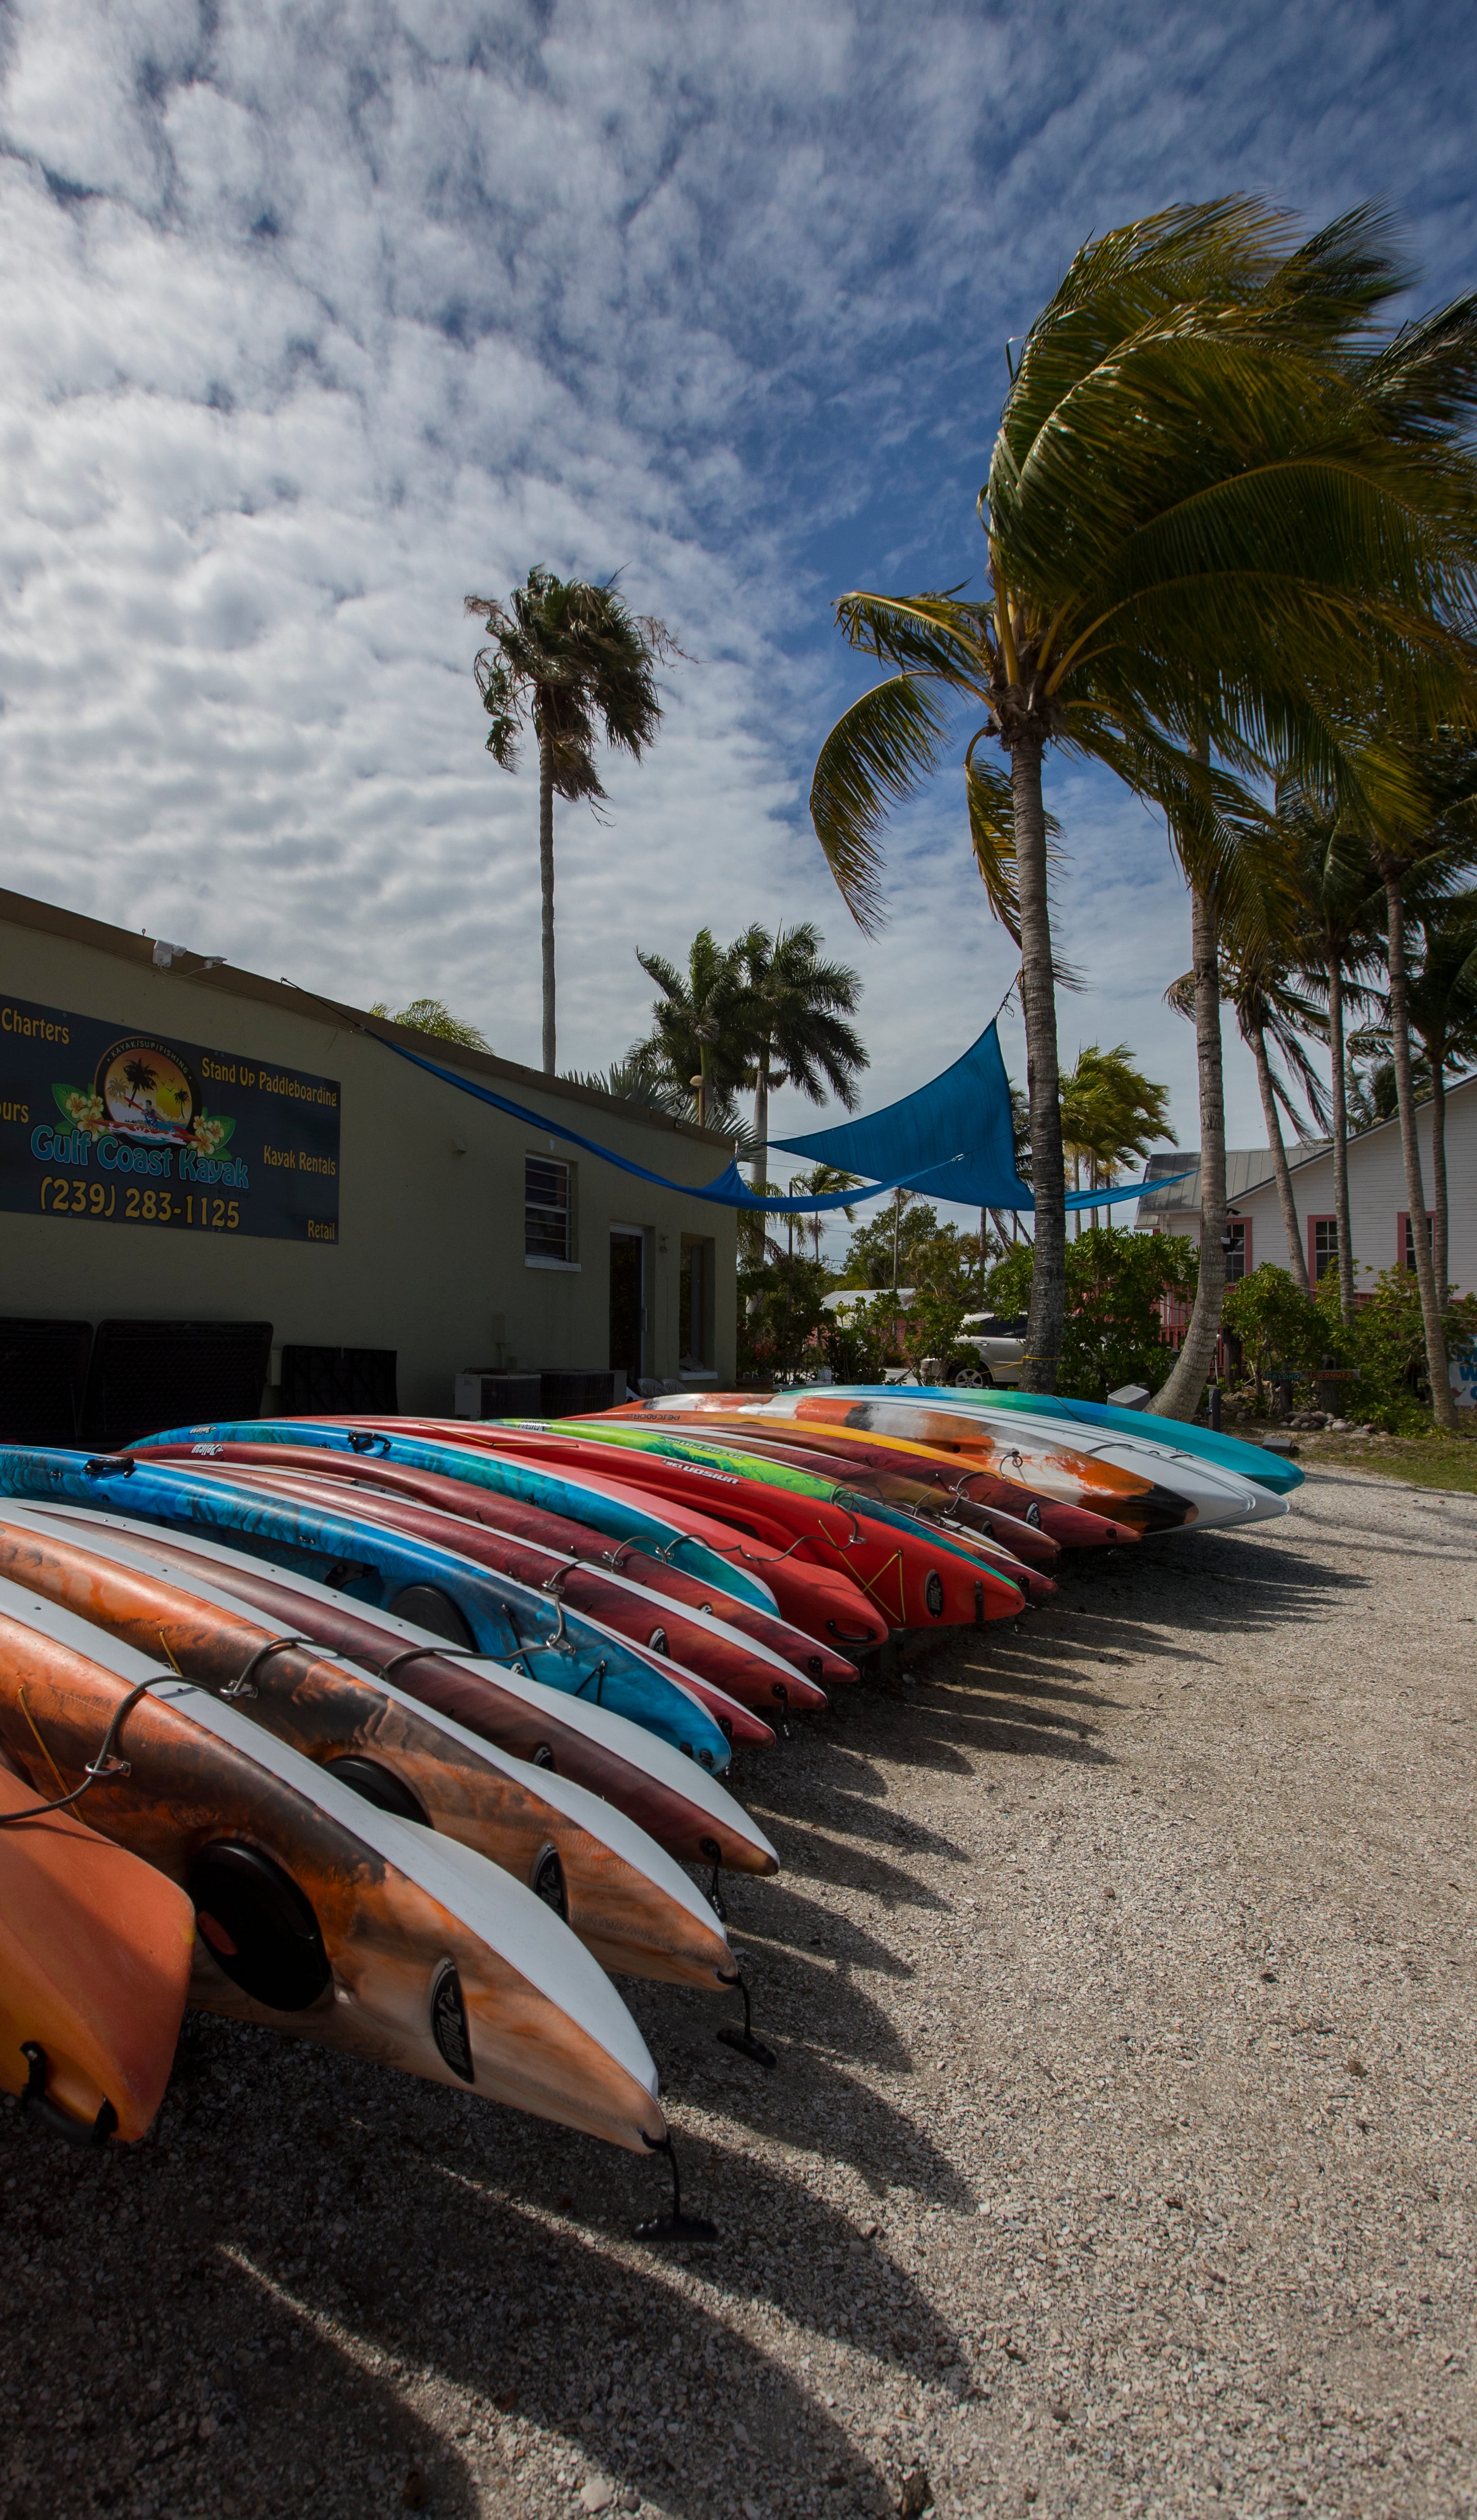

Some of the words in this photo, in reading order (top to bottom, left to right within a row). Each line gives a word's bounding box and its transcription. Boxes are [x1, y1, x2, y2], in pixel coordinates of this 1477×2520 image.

[2, 1007, 70, 1045] Charters
[202, 1057, 236, 1083] Stand
[240, 1066, 256, 1087] Up
[260, 1070, 337, 1107] Paddleboarding
[0, 1101, 29, 1124] urs
[30, 1125, 92, 1166] Gulf
[97, 1136, 174, 1178] Coast
[179, 1148, 249, 1189] Kayak
[264, 1145, 296, 1169] Kayak
[299, 1151, 336, 1176] Rentals
[40, 1176, 116, 1218] (239)
[125, 1188, 240, 1229] 283-1125
[308, 1219, 335, 1240] Retail
